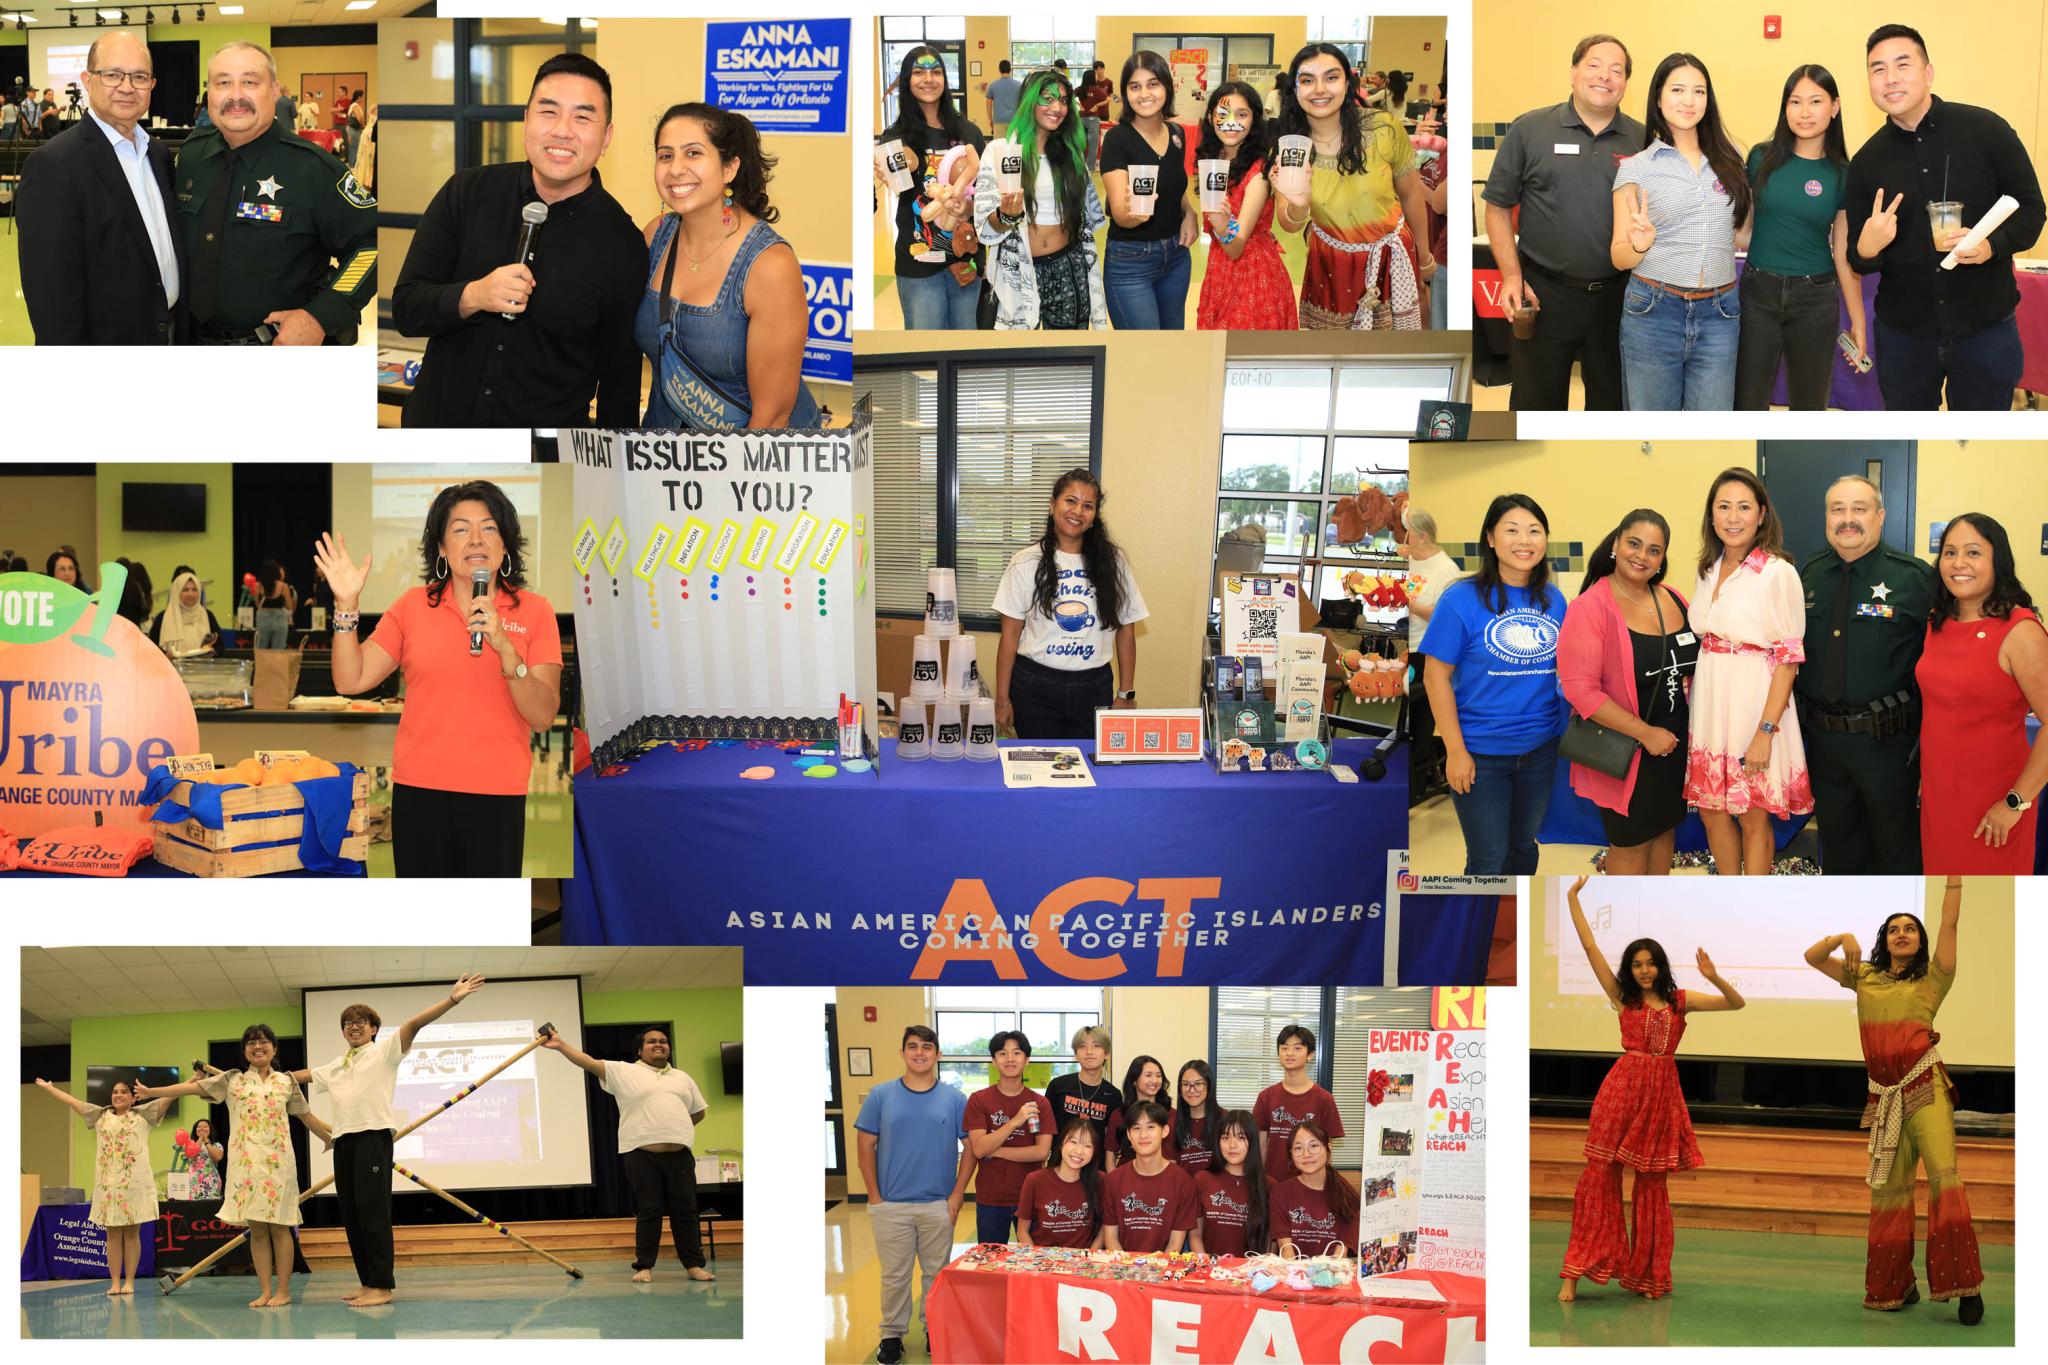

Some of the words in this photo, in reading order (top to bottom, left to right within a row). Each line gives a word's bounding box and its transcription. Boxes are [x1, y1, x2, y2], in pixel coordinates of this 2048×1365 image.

[740, 23, 812, 46] ANNA
[717, 46, 839, 69] ESKAMANI
[1171, 49, 1207, 64] REACH
[717, 83, 747, 92] Working
[748, 84, 760, 92] For
[778, 83, 808, 92] Fighting
[809, 82, 822, 92] For
[823, 82, 833, 92] Us
[718, 93, 735, 106] For
[736, 93, 770, 108] Mayor
[771, 92, 784, 108] Of
[787, 92, 830, 106] Orlando
[1003, 158, 1022, 166] ACT
[1283, 148, 1306, 158] ACT
[1134, 178, 1154, 188] ACT
[1209, 172, 1228, 183] ACT
[684, 380, 726, 417] ANNA
[570, 429, 612, 468] WHAT
[625, 440, 728, 472] ISSUES
[744, 441, 851, 472] MATTER
[854, 432, 870, 471] MOST
[662, 480, 703, 512] TO
[730, 480, 813, 512] YOU?
[576, 529, 592, 556] CLIMATE
[678, 528, 700, 564] INFLATION
[712, 526, 734, 564] ECONOMY
[750, 528, 768, 561] HOUSING
[784, 520, 811, 566] IMMIGRATION
[818, 526, 842, 565] EDUCATION
[581, 538, 596, 566] CHANGE
[642, 533, 666, 572] HEALTHCARE
[0, 590, 54, 627] OTE
[1496, 608, 1516, 620] ASIAN
[1517, 608, 1552, 620] AMERICAN
[1046, 642, 1095, 660] voting
[1486, 644, 1519, 664] CHAMBER
[914, 670, 937, 680] ACT
[28, 680, 103, 702] MAYRA
[902, 733, 923, 744] ACT
[939, 733, 960, 744] ACT
[970, 734, 993, 744] ACT
[47, 788, 116, 806] COUNTY
[44, 842, 123, 860] Uribe
[51, 860, 75, 868] ORANGE
[100, 862, 120, 870] MAYOR
[1442, 876, 1472, 884] Coming
[1474, 876, 1508, 885] Together
[726, 911, 832, 930] ASIAN
[851, 912, 1030, 931] AMERICAN
[1050, 912, 1196, 931] PACIFIC
[1213, 902, 1382, 928] ISLANDERS
[910, 876, 1222, 980] ACT
[900, 932, 1040, 950] COMING
[1060, 930, 1230, 948] TOGETHER
[1370, 1030, 1430, 1054] EVENTS
[412, 1048, 474, 1075] ACT
[1064, 1095, 1090, 1108] WINTER
[1090, 1102, 1108, 1112] PARK
[1064, 1102, 1106, 1118] VOLLEYBALL
[1427, 1141, 1466, 1152] REACH
[59, 1218, 80, 1228] Legal
[81, 1221, 94, 1229] Aid
[1418, 1226, 1448, 1238] REACH
[54, 1232, 81, 1244] Orange
[57, 1242, 100, 1256] Association,
